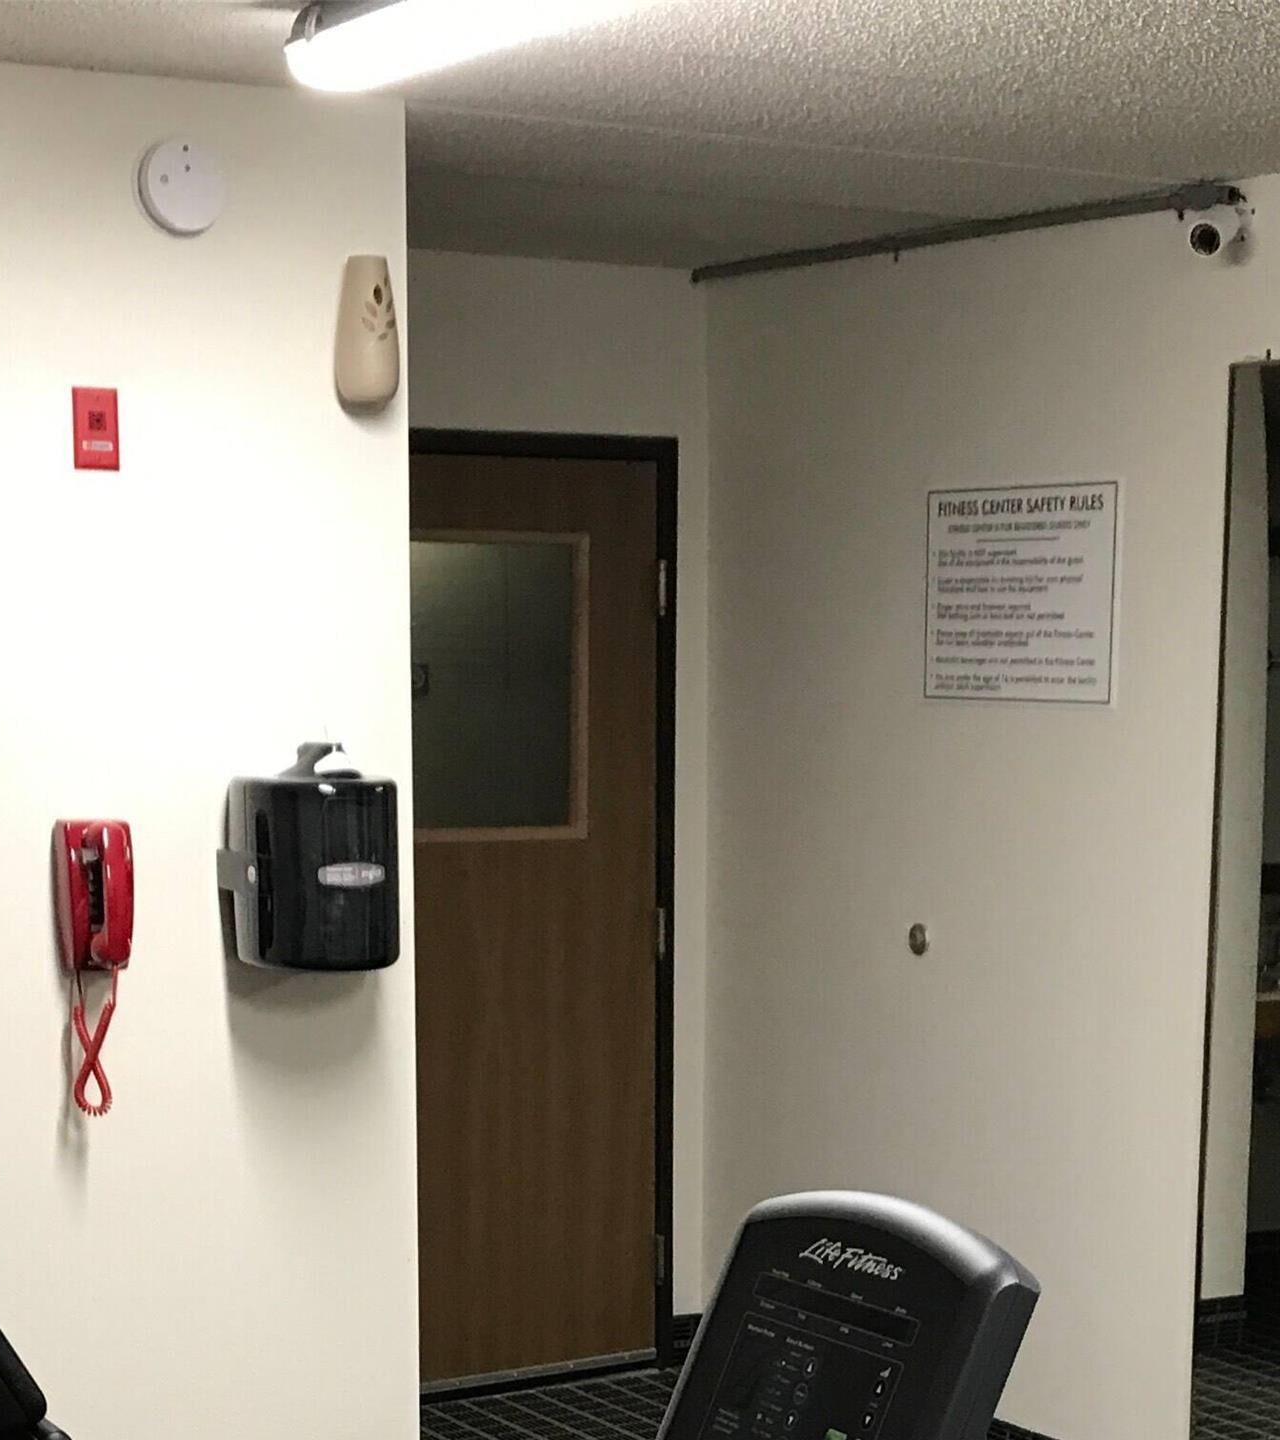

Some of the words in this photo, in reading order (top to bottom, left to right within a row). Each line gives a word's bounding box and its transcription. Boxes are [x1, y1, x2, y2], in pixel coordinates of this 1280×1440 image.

[938, 500, 979, 517] FITNESS
[982, 497, 1023, 514] CENTER
[1026, 495, 1065, 514] SAFETY
[1070, 493, 1104, 511] RULES
